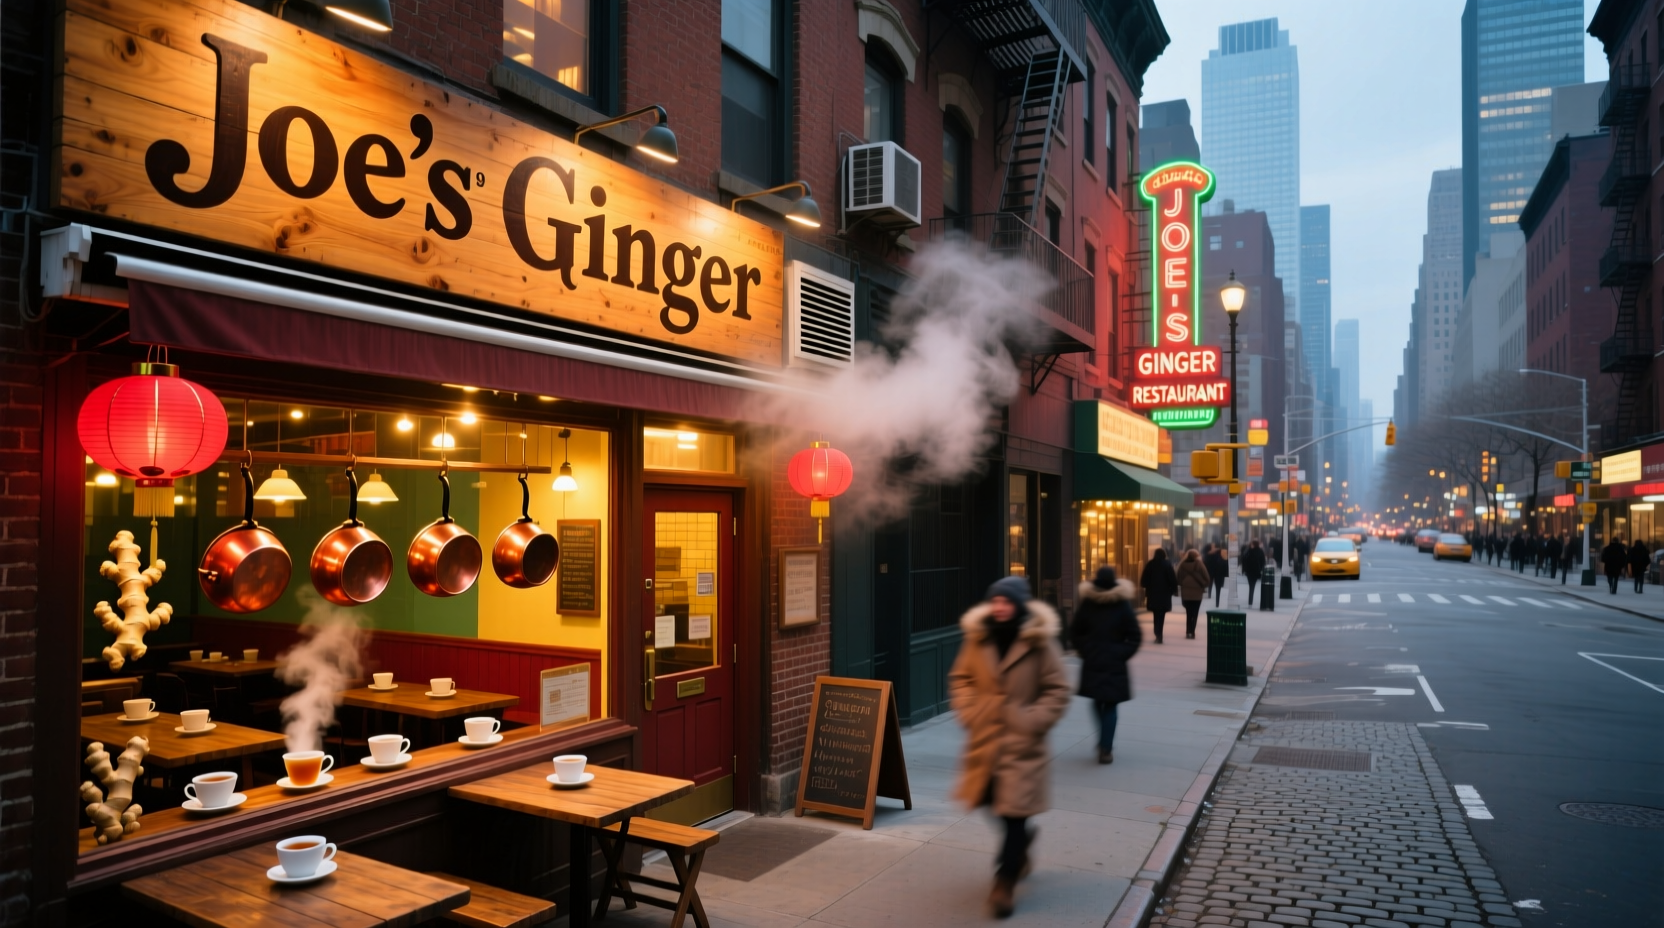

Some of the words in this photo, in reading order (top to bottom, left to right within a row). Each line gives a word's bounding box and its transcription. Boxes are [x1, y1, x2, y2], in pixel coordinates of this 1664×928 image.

[144, 32, 473, 241] Joe's
[502, 155, 761, 335] Ginger
[1138, 350, 1216, 375] GINGER
[1132, 383, 1227, 404] RESTAURANT
